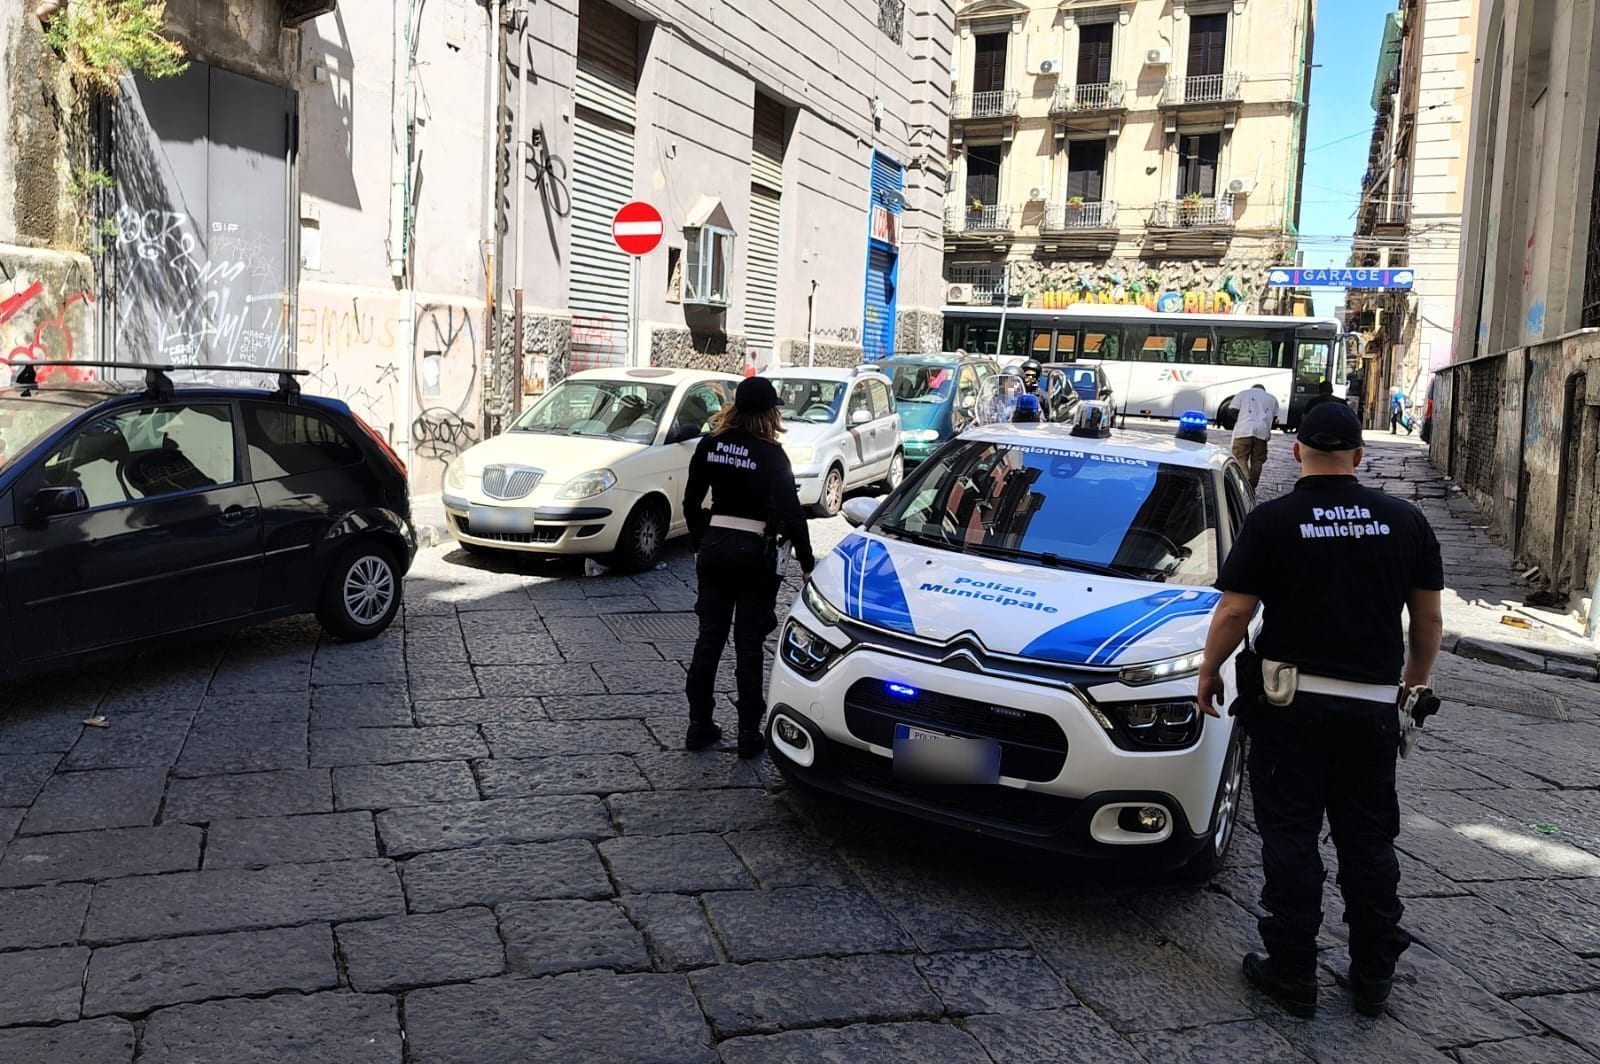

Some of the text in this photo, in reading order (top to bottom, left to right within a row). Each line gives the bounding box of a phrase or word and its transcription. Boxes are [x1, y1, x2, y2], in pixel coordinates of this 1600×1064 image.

[1302, 269, 1380, 281] GARAGE
[716, 441, 749, 457] Polizia
[706, 451, 758, 470] Municipale
[1312, 505, 1371, 521] Polizia
[1299, 520, 1391, 539] Municipale
[954, 577, 1037, 597] Polizia
[919, 583, 1059, 614] Municipale
